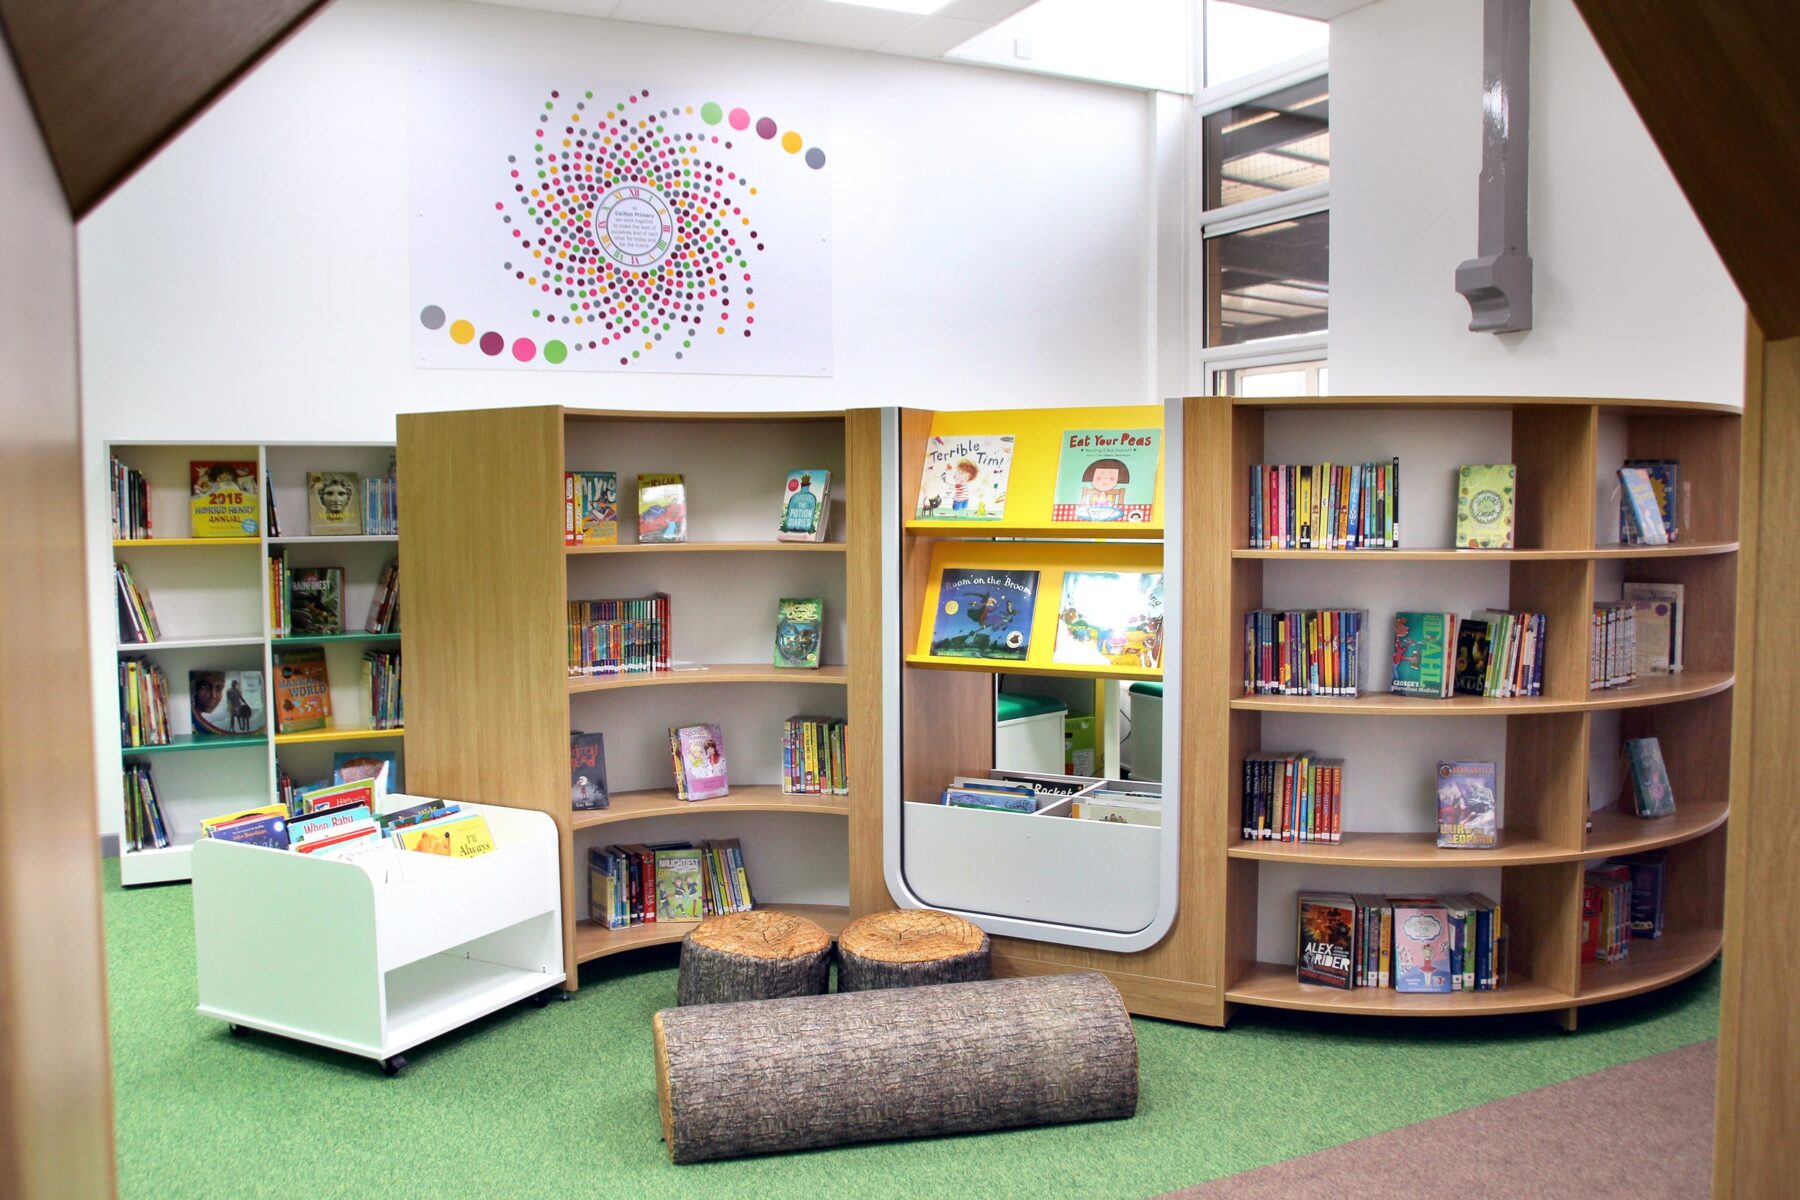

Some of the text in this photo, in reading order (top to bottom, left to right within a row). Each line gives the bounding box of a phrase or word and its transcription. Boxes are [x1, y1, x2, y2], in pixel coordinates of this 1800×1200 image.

[1070, 432, 1152, 448] Eat Your Peas
[929, 439, 980, 463] Terrible
[976, 451, 1005, 469] Tim!
[209, 492, 243, 505] 2015
[195, 505, 255, 515] HORRID HENRY
[789, 508, 812, 518] POTION
[208, 515, 242, 523] ANNUAL
[787, 518, 811, 527] DIARIES
[292, 580, 330, 591] RAINFOREST
[944, 575, 1032, 595] Room on the Broom
[1420, 624, 1442, 687] DAHL
[290, 684, 327, 697] WORLD
[1034, 783, 1073, 796] Rocket
[303, 822, 329, 834] When
[1446, 834, 1494, 844] LEOPARD
[459, 842, 491, 857] Always
[658, 857, 699, 869] NAUGHTIEST
[1305, 942, 1335, 955] ALEX
[1314, 954, 1351, 971] RIDER
